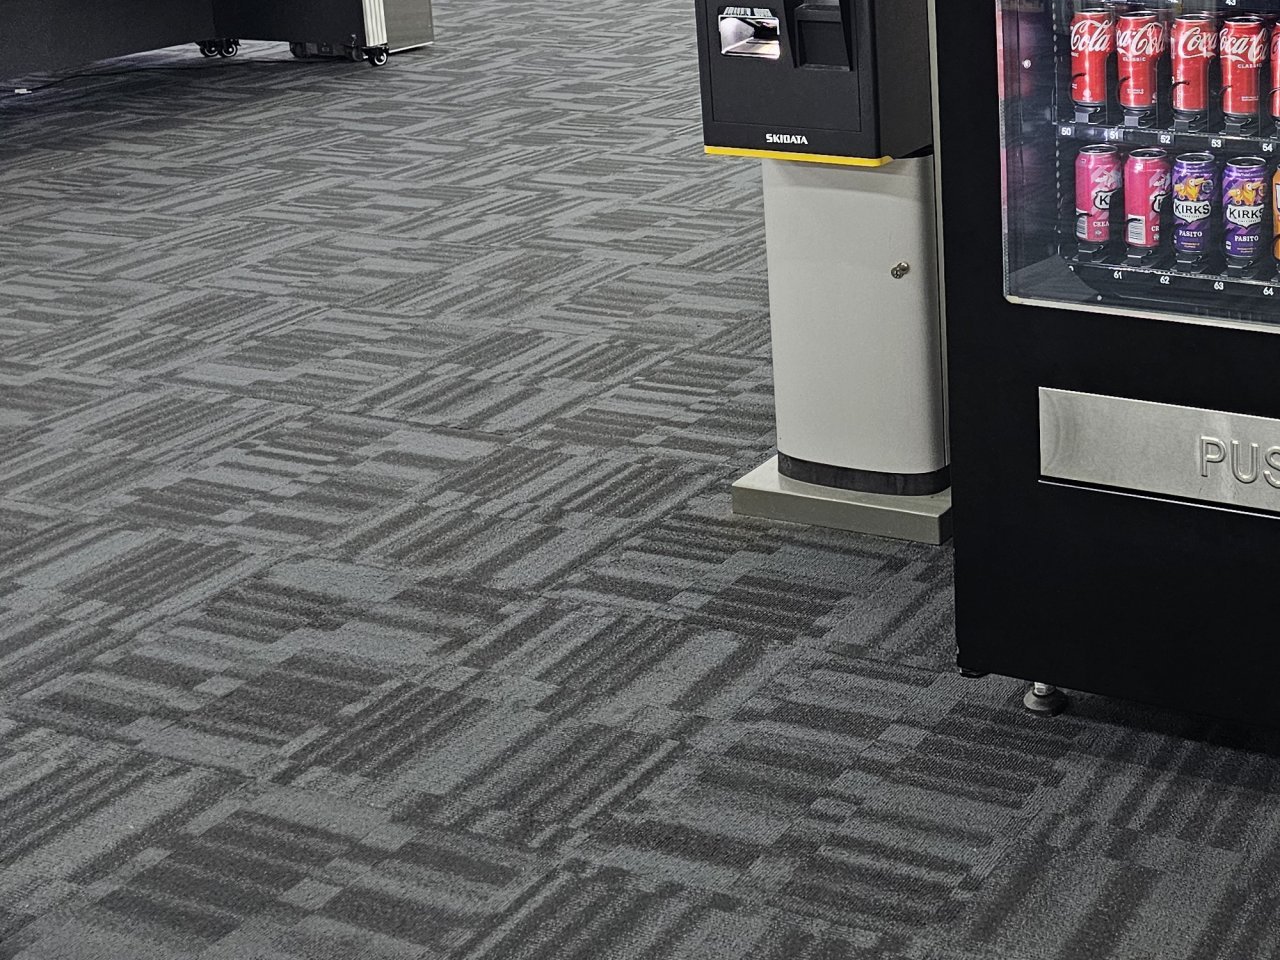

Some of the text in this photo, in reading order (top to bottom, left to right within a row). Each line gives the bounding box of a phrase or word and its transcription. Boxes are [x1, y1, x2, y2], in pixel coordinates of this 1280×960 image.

[1061, 127, 1072, 136] 50
[1109, 130, 1119, 140] 51
[766, 133, 809, 145] SKIDATA
[1160, 134, 1171, 144] 52
[1211, 138, 1222, 148] 53
[1262, 143, 1274, 152] 54
[1174, 202, 1211, 215] KIRKS
[1178, 229, 1204, 238] PASITO
[1234, 235, 1260, 243] PASITO
[1113, 270, 1123, 279] 61
[1159, 275, 1170, 285] 62
[1213, 280, 1224, 290] 63
[1262, 287, 1274, 296] 64
